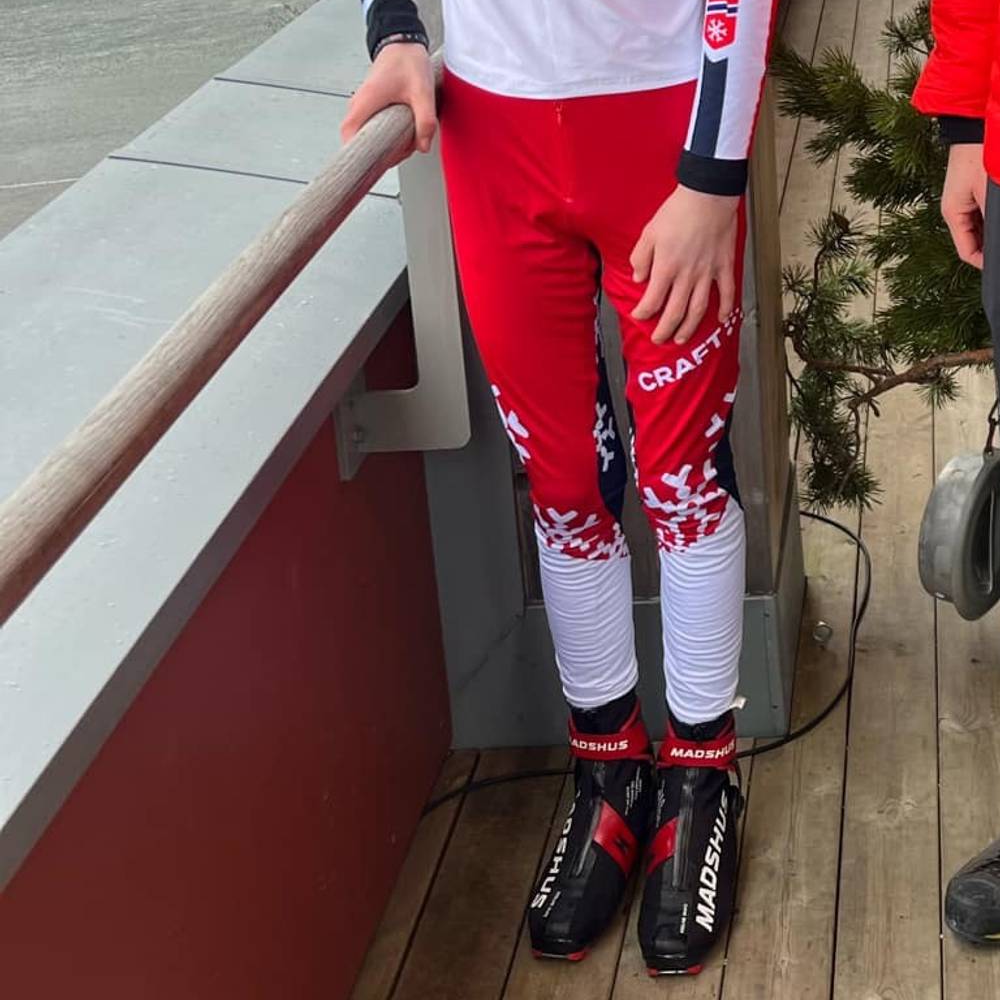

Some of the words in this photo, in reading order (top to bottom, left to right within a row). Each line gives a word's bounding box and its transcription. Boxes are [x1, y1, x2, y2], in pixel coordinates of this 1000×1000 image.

[638, 327, 722, 391] CRAFT
[570, 737, 630, 753] ADSHUS
[695, 789, 730, 933] MADSHUS
